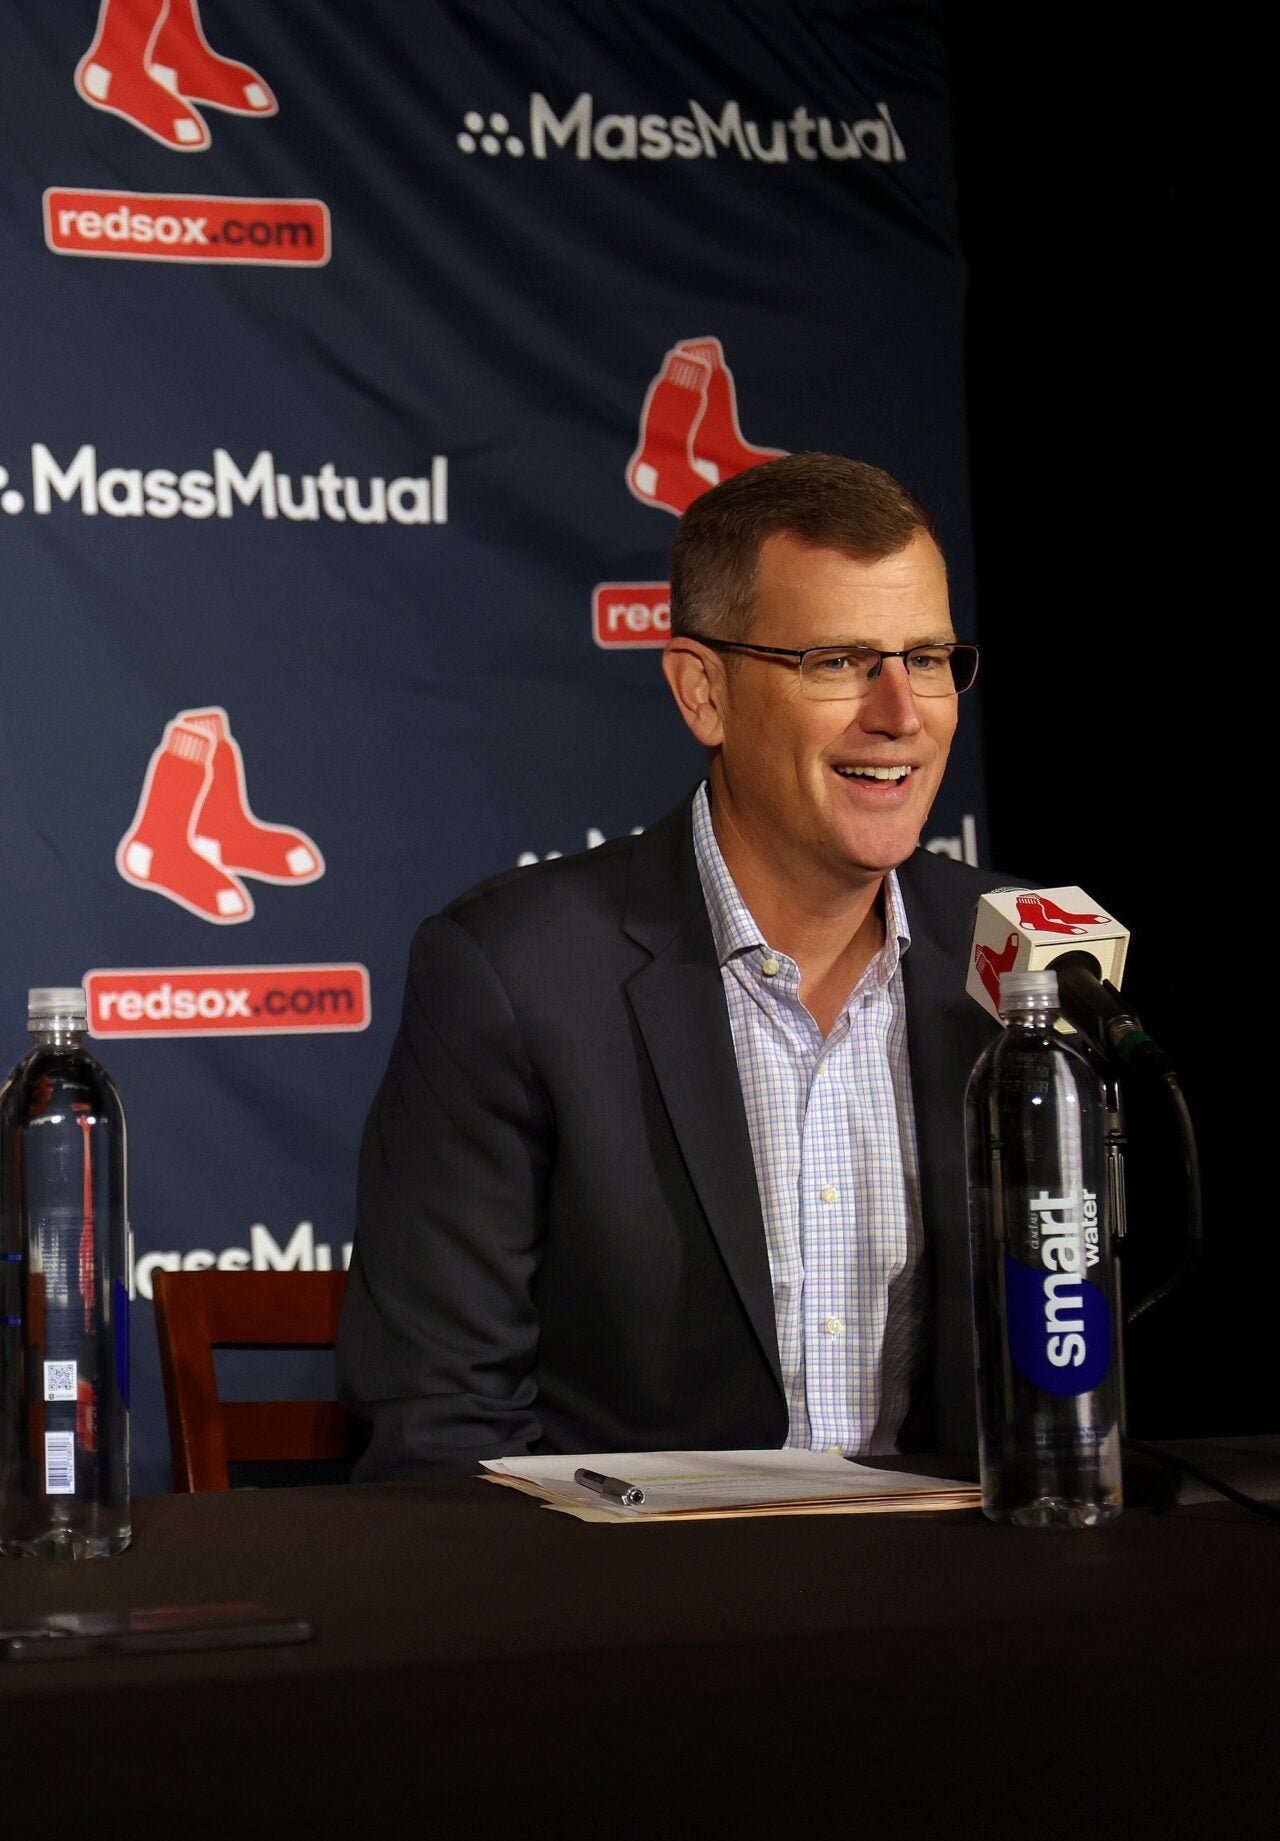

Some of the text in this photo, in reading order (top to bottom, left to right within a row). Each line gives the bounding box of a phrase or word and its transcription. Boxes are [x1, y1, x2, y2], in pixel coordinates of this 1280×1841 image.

[530, 92, 906, 162] MassMutual
[58, 204, 315, 248] redsox.com
[31, 443, 448, 524] MassMutual
[98, 982, 354, 1021] redsox.com
[1081, 1188, 1100, 1268] water
[1030, 1190, 1087, 1367] smart
